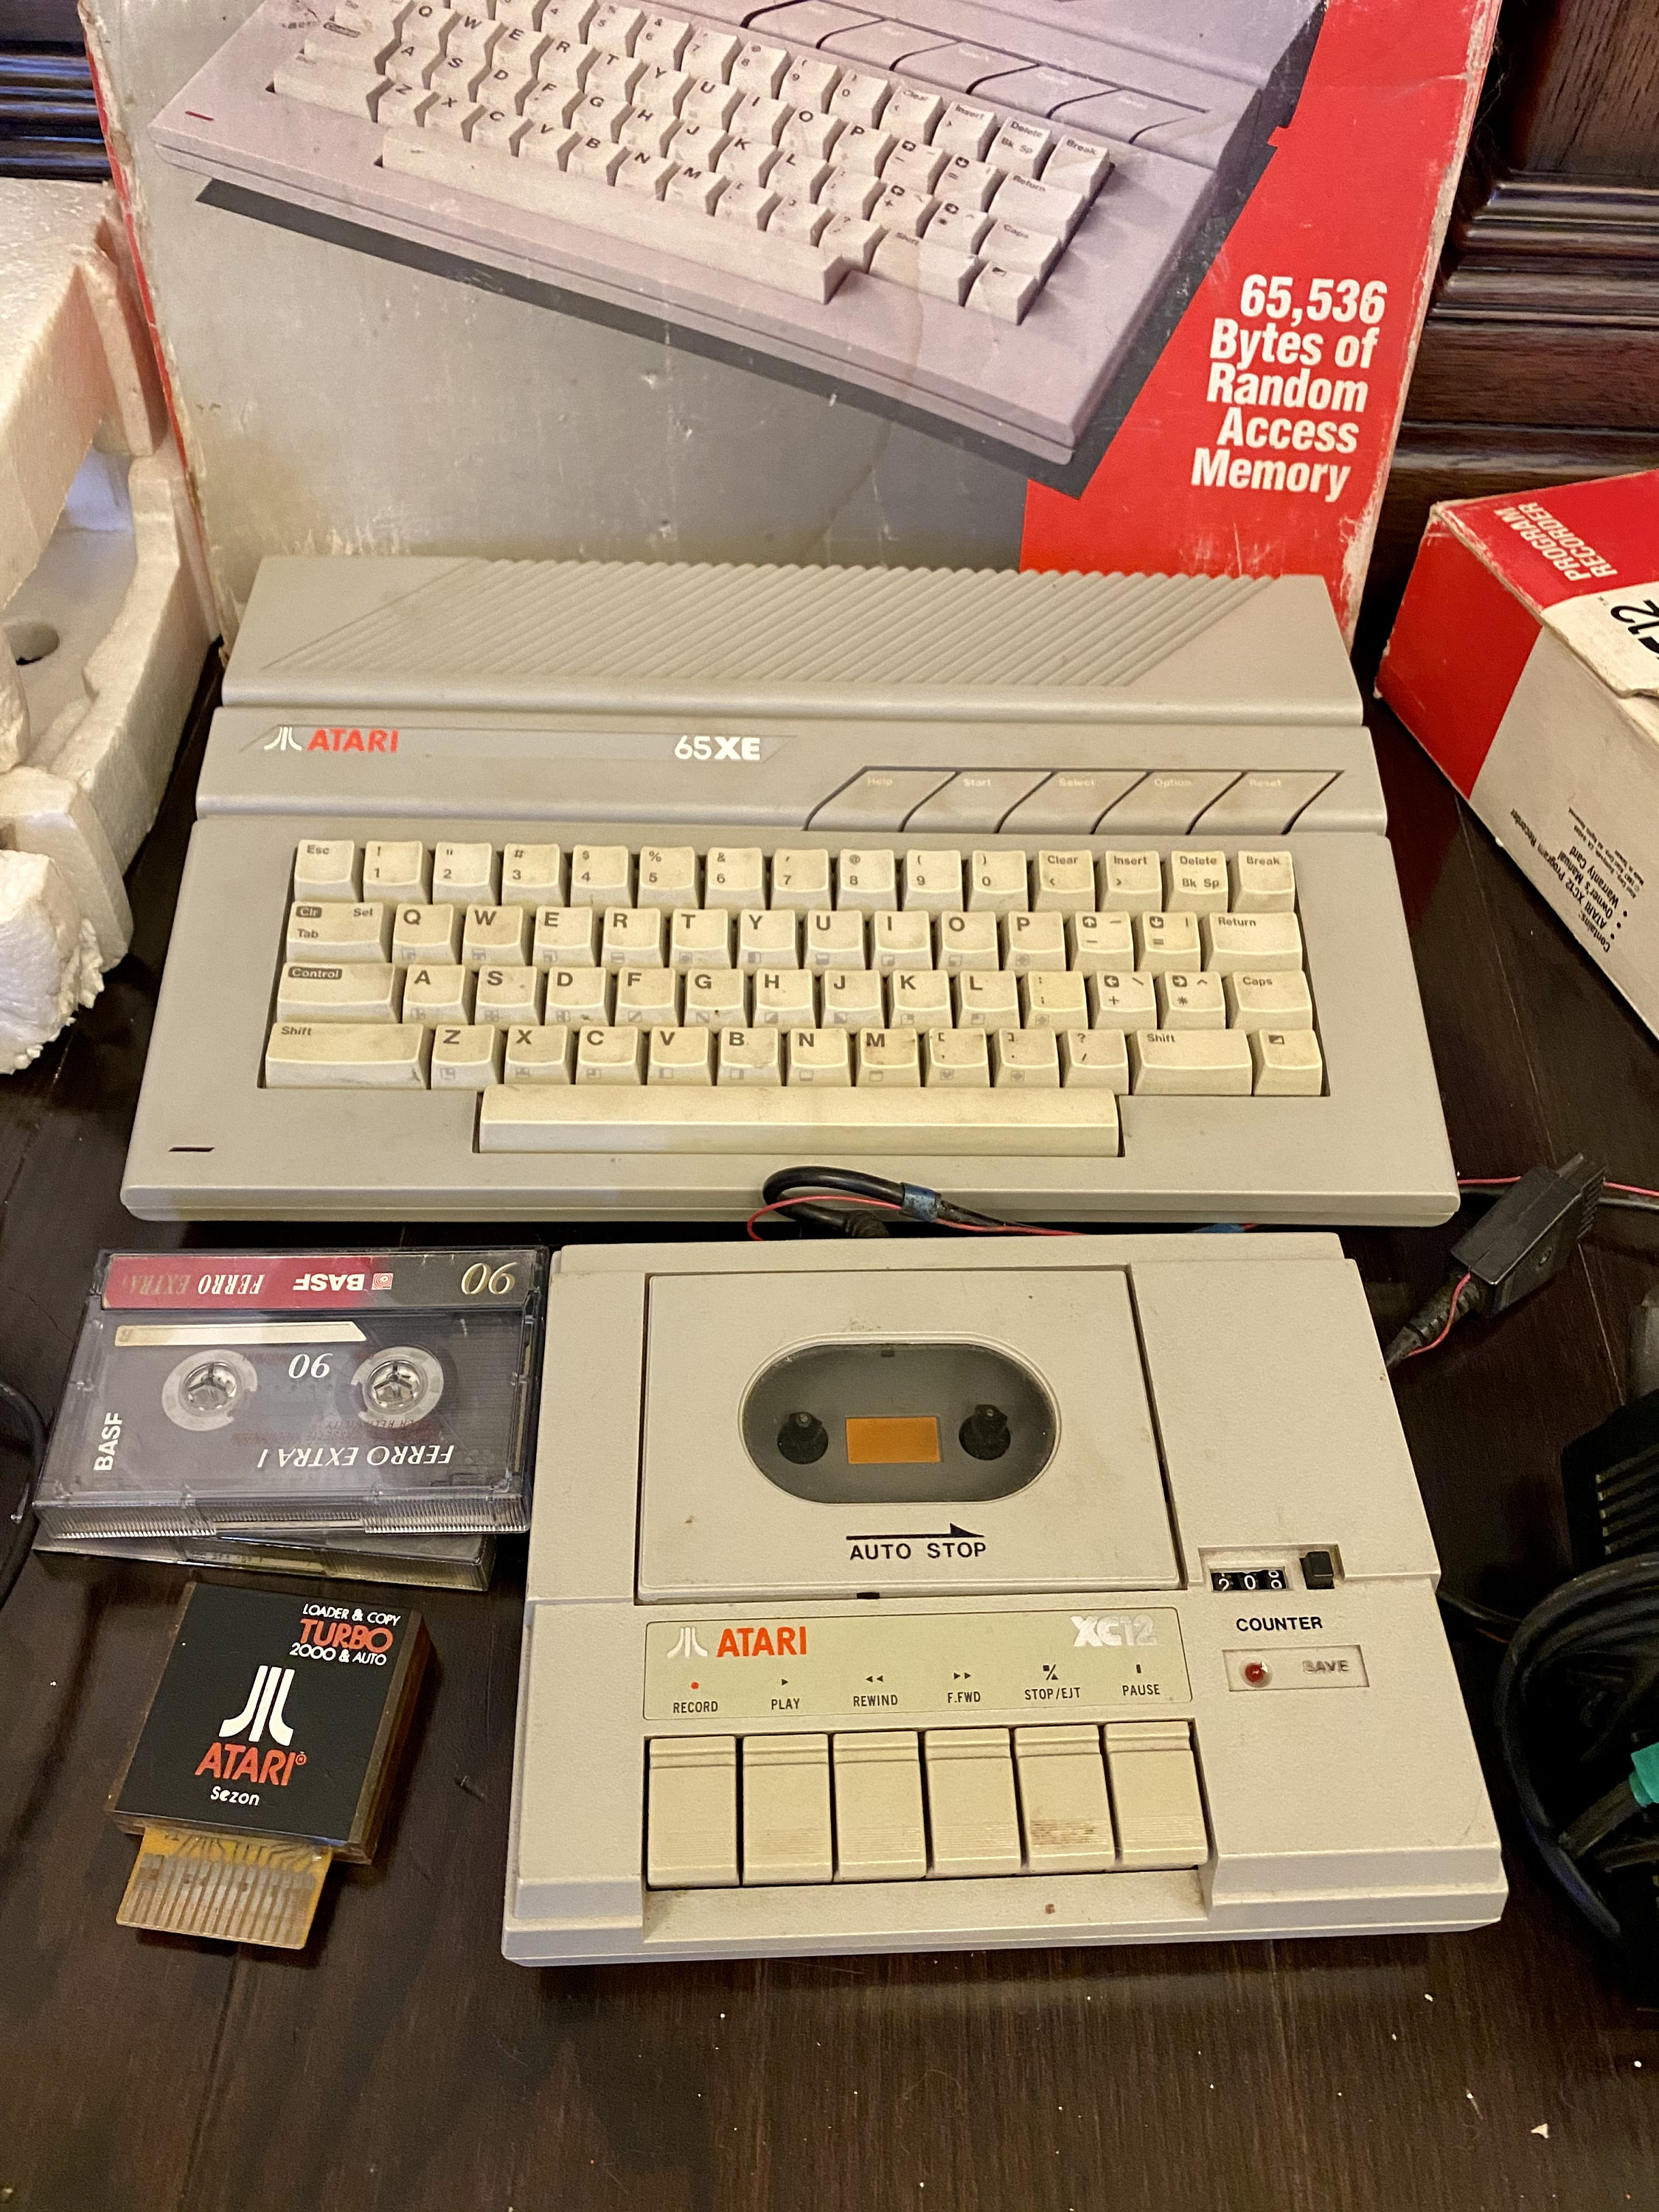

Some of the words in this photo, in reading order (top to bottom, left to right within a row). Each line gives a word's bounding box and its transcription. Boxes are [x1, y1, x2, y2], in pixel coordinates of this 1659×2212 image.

[465, 15, 482, 29] W
[509, 28, 524, 41] E
[401, 46, 414, 57] A
[556, 41, 571, 53] R
[448, 58, 463, 68] S
[608, 53, 619, 66] T
[493, 69, 509, 80] D
[655, 66, 667, 79] Y
[541, 83, 557, 92] F
[700, 81, 715, 94] U
[590, 96, 605, 108] G
[489, 111, 505, 122] C
[638, 109, 653, 122] H
[540, 124, 553, 134] V
[686, 125, 700, 136] J
[849, 125, 865, 138] P
[585, 138, 601, 149] B
[734, 138, 751, 152] K
[1066, 139, 1097, 156] Break
[634, 152, 650, 164] N
[785, 153, 797, 167] L
[684, 167, 701, 179] M
[1240, 274, 1387, 327] 65,536
[1210, 317, 1324, 370] Bytes
[1335, 327, 1380, 369] of
[1206, 362, 1368, 412] Random
[1217, 406, 1359, 453] Access
[1191, 448, 1351, 503] Memory
[1494, 507, 1591, 581] PROGRAM
[1518, 502, 1618, 578] RECORDER
[307, 729, 399, 753] ATARI
[674, 735, 761, 760] 65XE
[963, 778, 991, 787] Start
[306, 844, 329, 855] Esc
[1047, 855, 1079, 864] Clear
[1113, 855, 1147, 865] Insert
[1180, 855, 1217, 866] Delete
[1246, 855, 1280, 866] Break
[1538, 843, 1565, 883] Program
[1568, 846, 1587, 869] Card
[374, 868, 380, 878] 1
[444, 869, 452, 879] 2
[512, 869, 521, 880] 3
[1557, 849, 1584, 886] Manual
[581, 872, 591, 882] 4
[649, 872, 658, 883] 5
[717, 873, 726, 884] 6
[783, 874, 793, 886] 7
[849, 875, 858, 886] 8
[917, 875, 925, 886] 9
[1182, 878, 1197, 888] Bk
[1203, 878, 1220, 890] Sp
[1565, 877, 1585, 905] XC12
[1587, 864, 1620, 909] Warranty
[1585, 880, 1613, 919] Owner's
[299, 907, 317, 917] Clr
[403, 909, 422, 925] Q
[474, 909, 497, 925] W
[544, 911, 559, 927] E
[1585, 901, 1607, 930] ATARI
[613, 913, 627, 928] R
[681, 914, 696, 928] T
[748, 914, 763, 930] Y
[815, 915, 831, 931] U
[1016, 917, 1030, 931] P
[1217, 917, 1256, 927] Return
[297, 928, 319, 939] Tab
[292, 968, 339, 979] Control
[414, 970, 431, 984] A
[487, 971, 503, 986] S
[557, 972, 573, 987] D
[627, 973, 641, 986] F
[695, 974, 712, 989] G
[765, 974, 779, 989] H
[833, 975, 846, 990] J
[900, 975, 916, 990] K
[969, 975, 982, 990] L
[1242, 976, 1273, 988] Caps
[281, 1026, 311, 1036] Shift
[443, 1029, 461, 1045] Z
[516, 1029, 532, 1045] X
[586, 1030, 605, 1046] C
[1147, 1033, 1175, 1043] Shift
[660, 1032, 675, 1046] V
[729, 1032, 745, 1046] B
[799, 1033, 815, 1047] N
[866, 1033, 886, 1047] M
[198, 1274, 265, 1294] FERRO
[293, 1273, 365, 1290] BASF
[461, 1262, 517, 1295] 90
[288, 1353, 333, 1379] 90
[93, 1412, 123, 1471] BASF
[279, 1447, 359, 1467] EXTRA
[366, 1445, 454, 1465] FERRO
[849, 1543, 911, 1561] AUTO
[927, 1541, 987, 1559] STOP
[302, 1603, 349, 1620] LOADER
[352, 1608, 364, 1621] &
[367, 1612, 401, 1626] COPY
[1237, 1616, 1323, 1631] COUNTER
[300, 1618, 394, 1653] TURBO
[717, 1626, 807, 1658] ATARI
[1071, 1614, 1158, 1646] XC12
[290, 1642, 336, 1662] 2000
[338, 1649, 350, 1663] &
[352, 1652, 387, 1666] AUTO
[1303, 1660, 1349, 1673] SAVE
[947, 1691, 981, 1703] F.FWD
[1025, 1687, 1081, 1701] STOP/EJT
[1122, 1684, 1161, 1696] PAUSE
[673, 1701, 718, 1714] RECORD
[771, 1698, 800, 1710] PLAY
[853, 1694, 898, 1707] REWIND
[211, 1786, 260, 1806] Sezon
